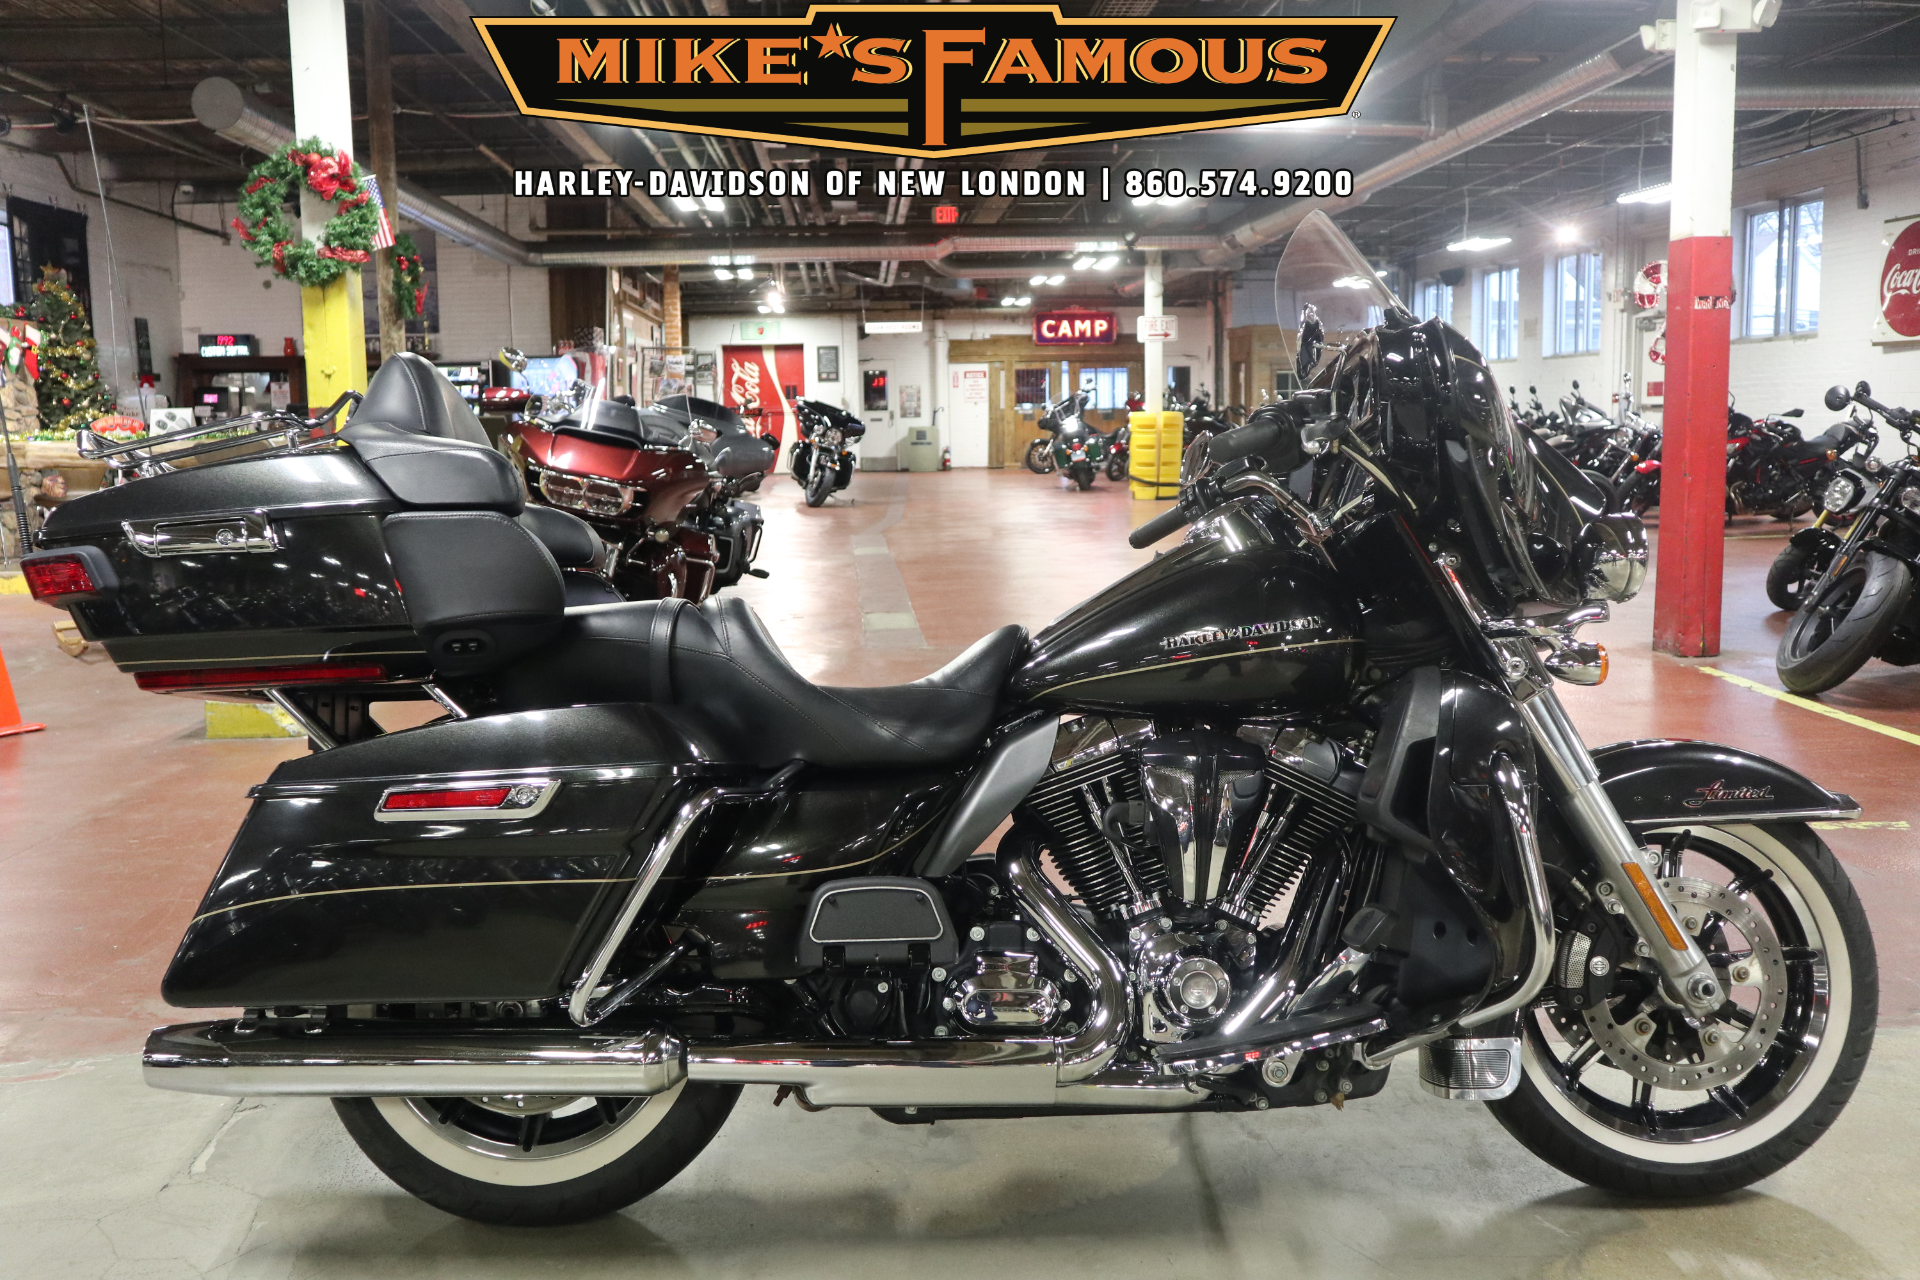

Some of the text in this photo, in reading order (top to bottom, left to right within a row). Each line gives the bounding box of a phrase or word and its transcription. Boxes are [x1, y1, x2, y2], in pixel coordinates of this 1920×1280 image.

[936, 206, 957, 223] EXIT
[1041, 319, 1109, 338] CAMP
[1144, 319, 1175, 331] FIRE EXIT
[217, 335, 236, 346] 1992
[1682, 779, 1775, 808] Limited
